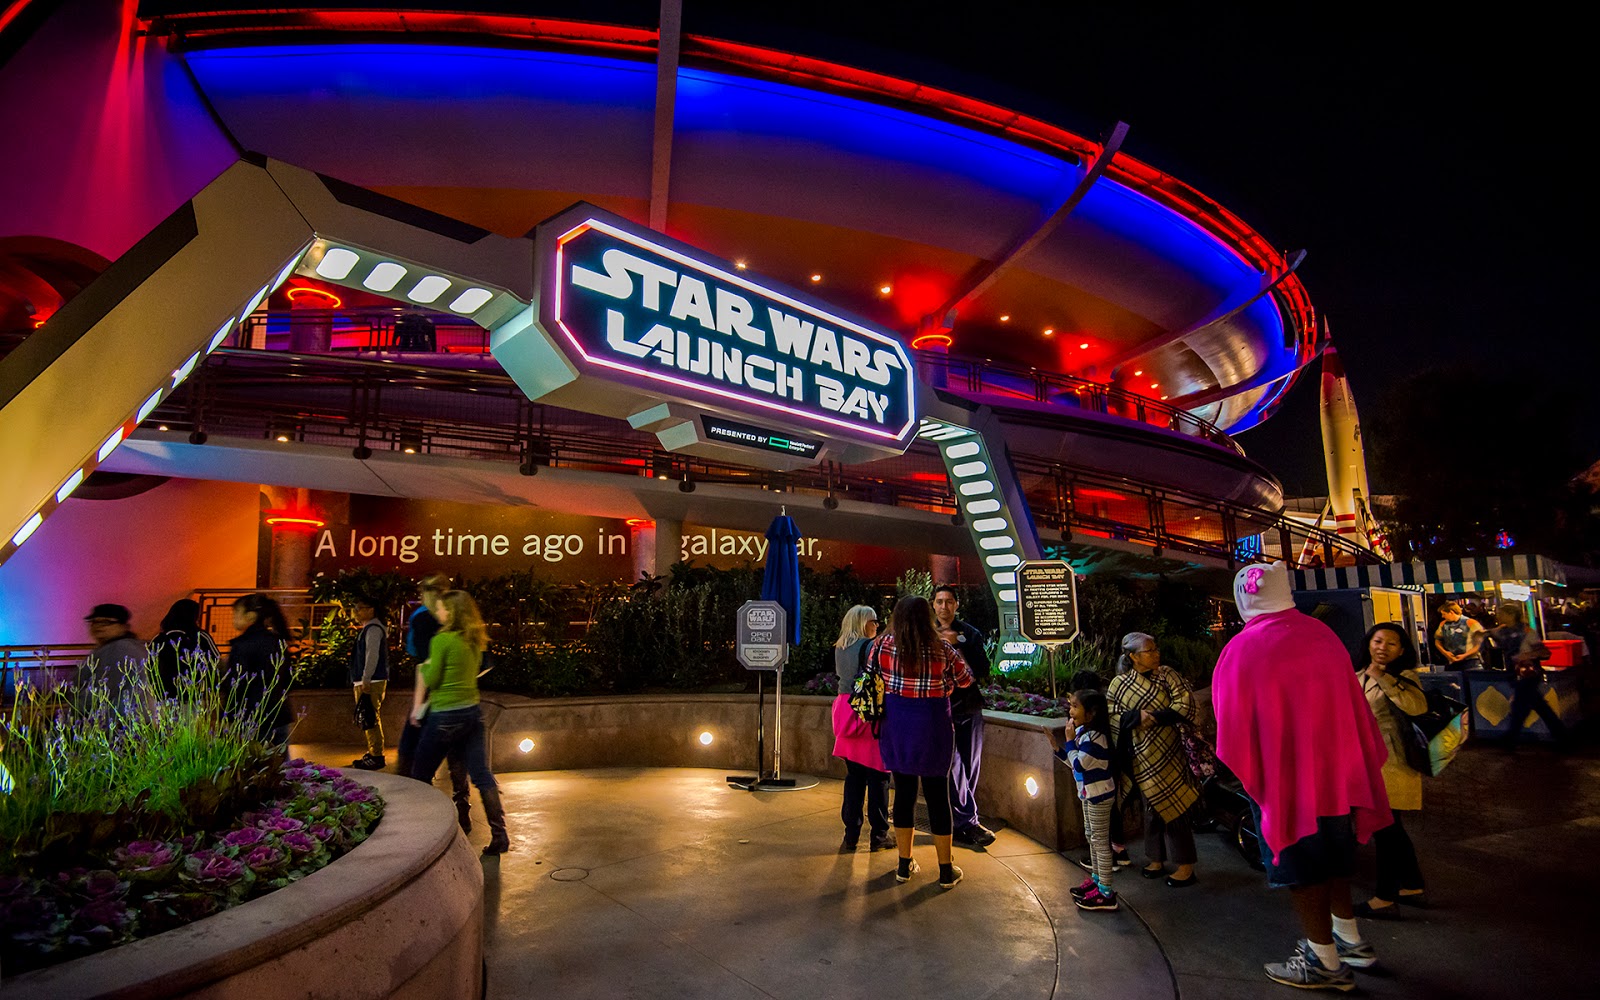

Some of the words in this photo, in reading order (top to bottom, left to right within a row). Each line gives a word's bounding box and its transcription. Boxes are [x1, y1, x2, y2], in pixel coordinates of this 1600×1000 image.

[572, 248, 765, 346] STAR
[768, 306, 904, 386] WARS
[606, 309, 803, 401] LAUNCH
[815, 375, 889, 423] BAY
[711, 426, 756, 441] PRESENTED
[757, 436, 768, 444] BY
[314, 529, 337, 558] A
[349, 529, 421, 564] long
[431, 527, 510, 556] time
[522, 534, 584, 563] ago
[598, 527, 626, 555] in
[796, 537, 822, 561] ar,
